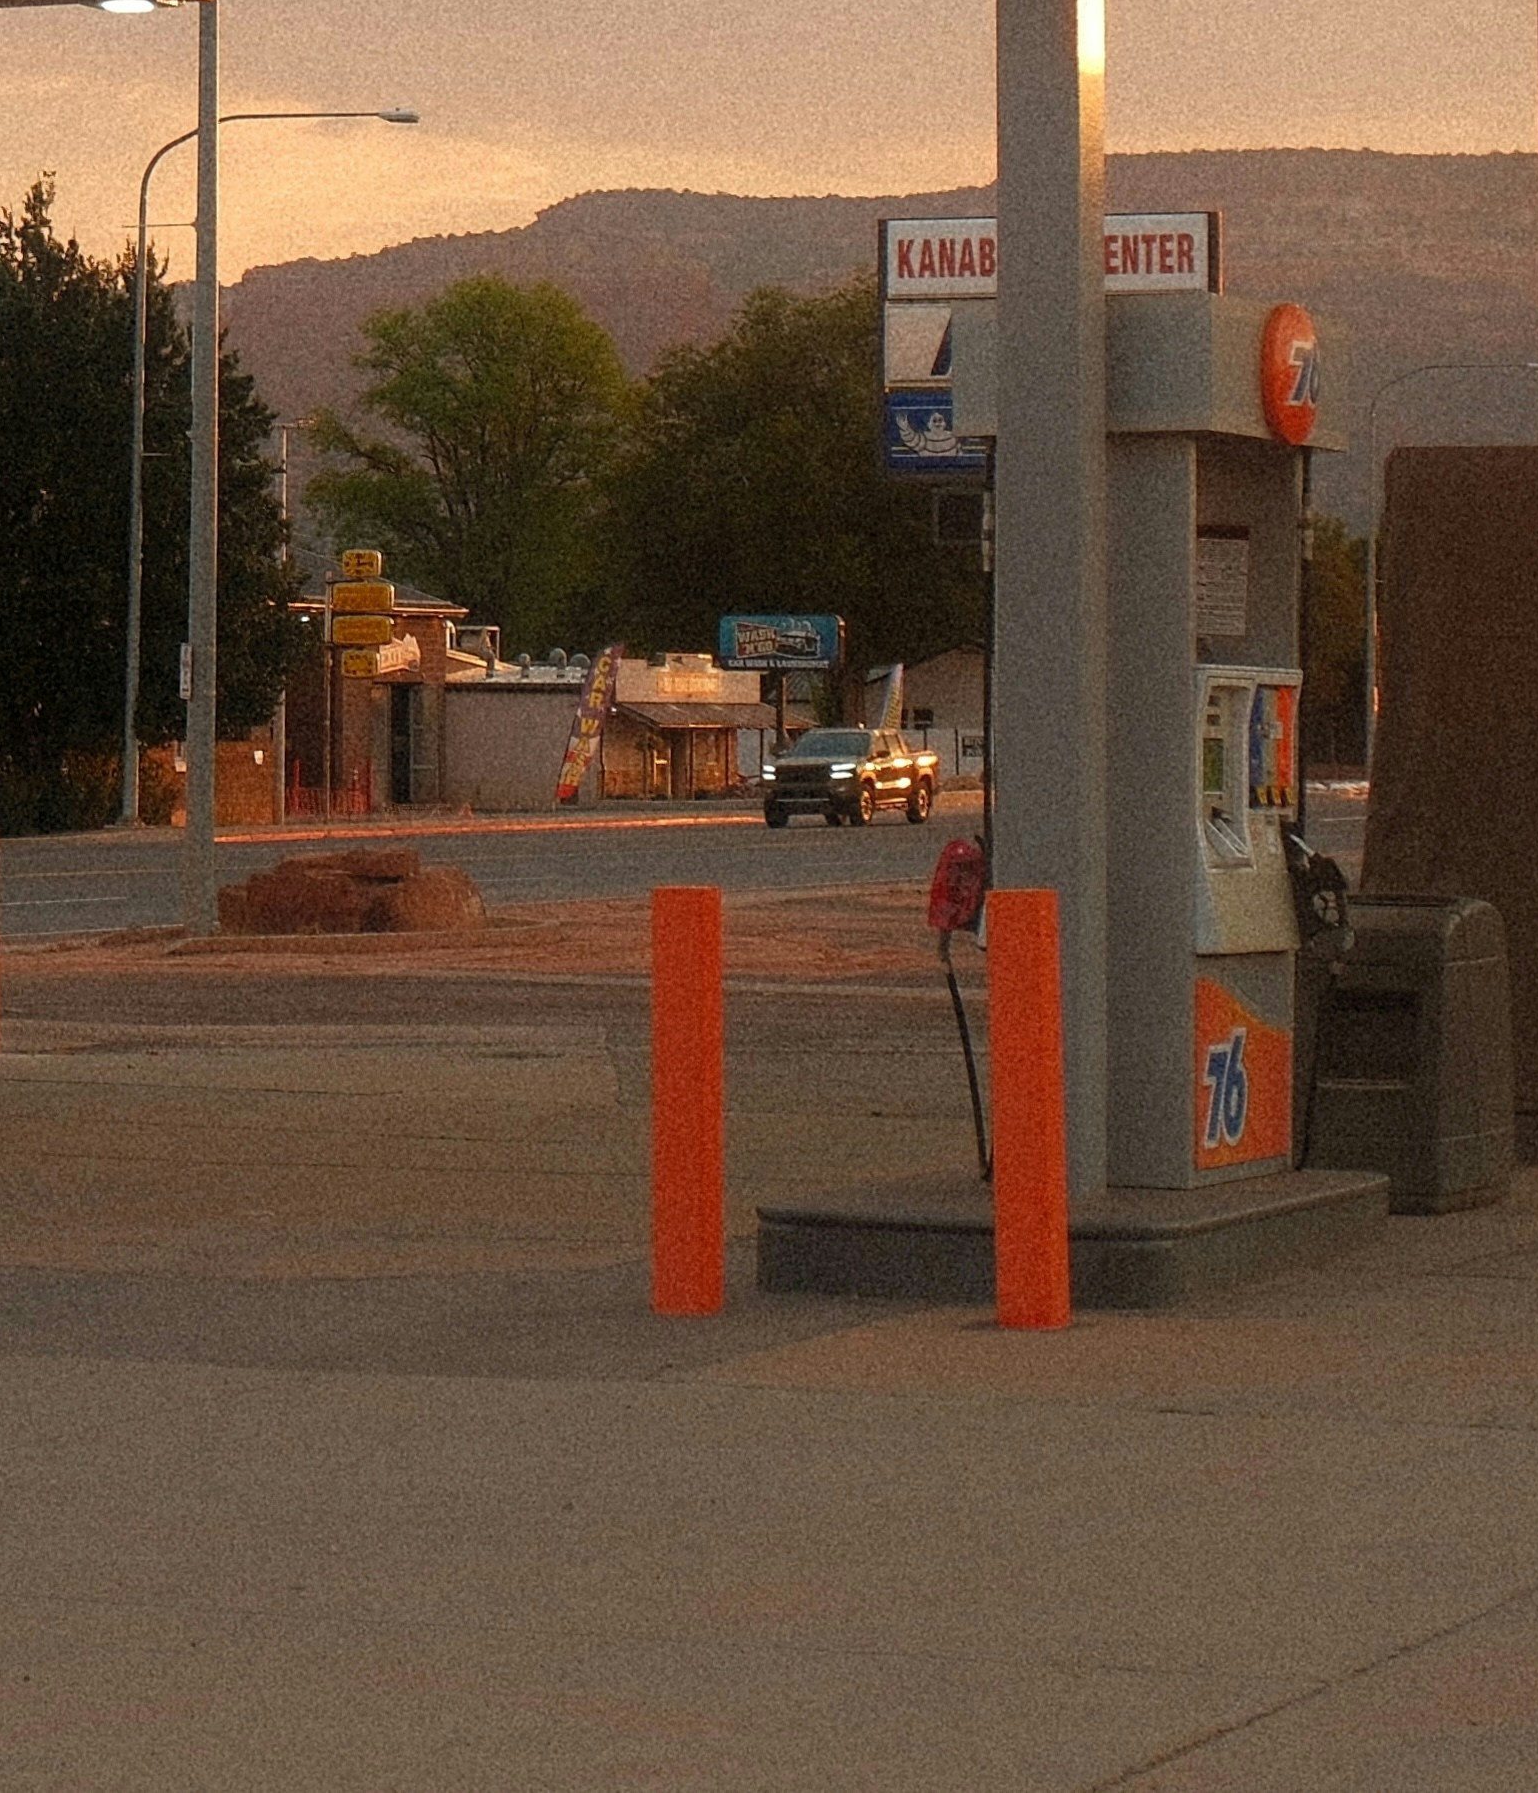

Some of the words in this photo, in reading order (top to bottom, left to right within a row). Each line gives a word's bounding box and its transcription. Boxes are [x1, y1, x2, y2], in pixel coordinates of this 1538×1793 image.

[897, 238, 996, 278] KANAB
[588, 656, 612, 707] CAR
[1203, 1027, 1247, 1149] 76
